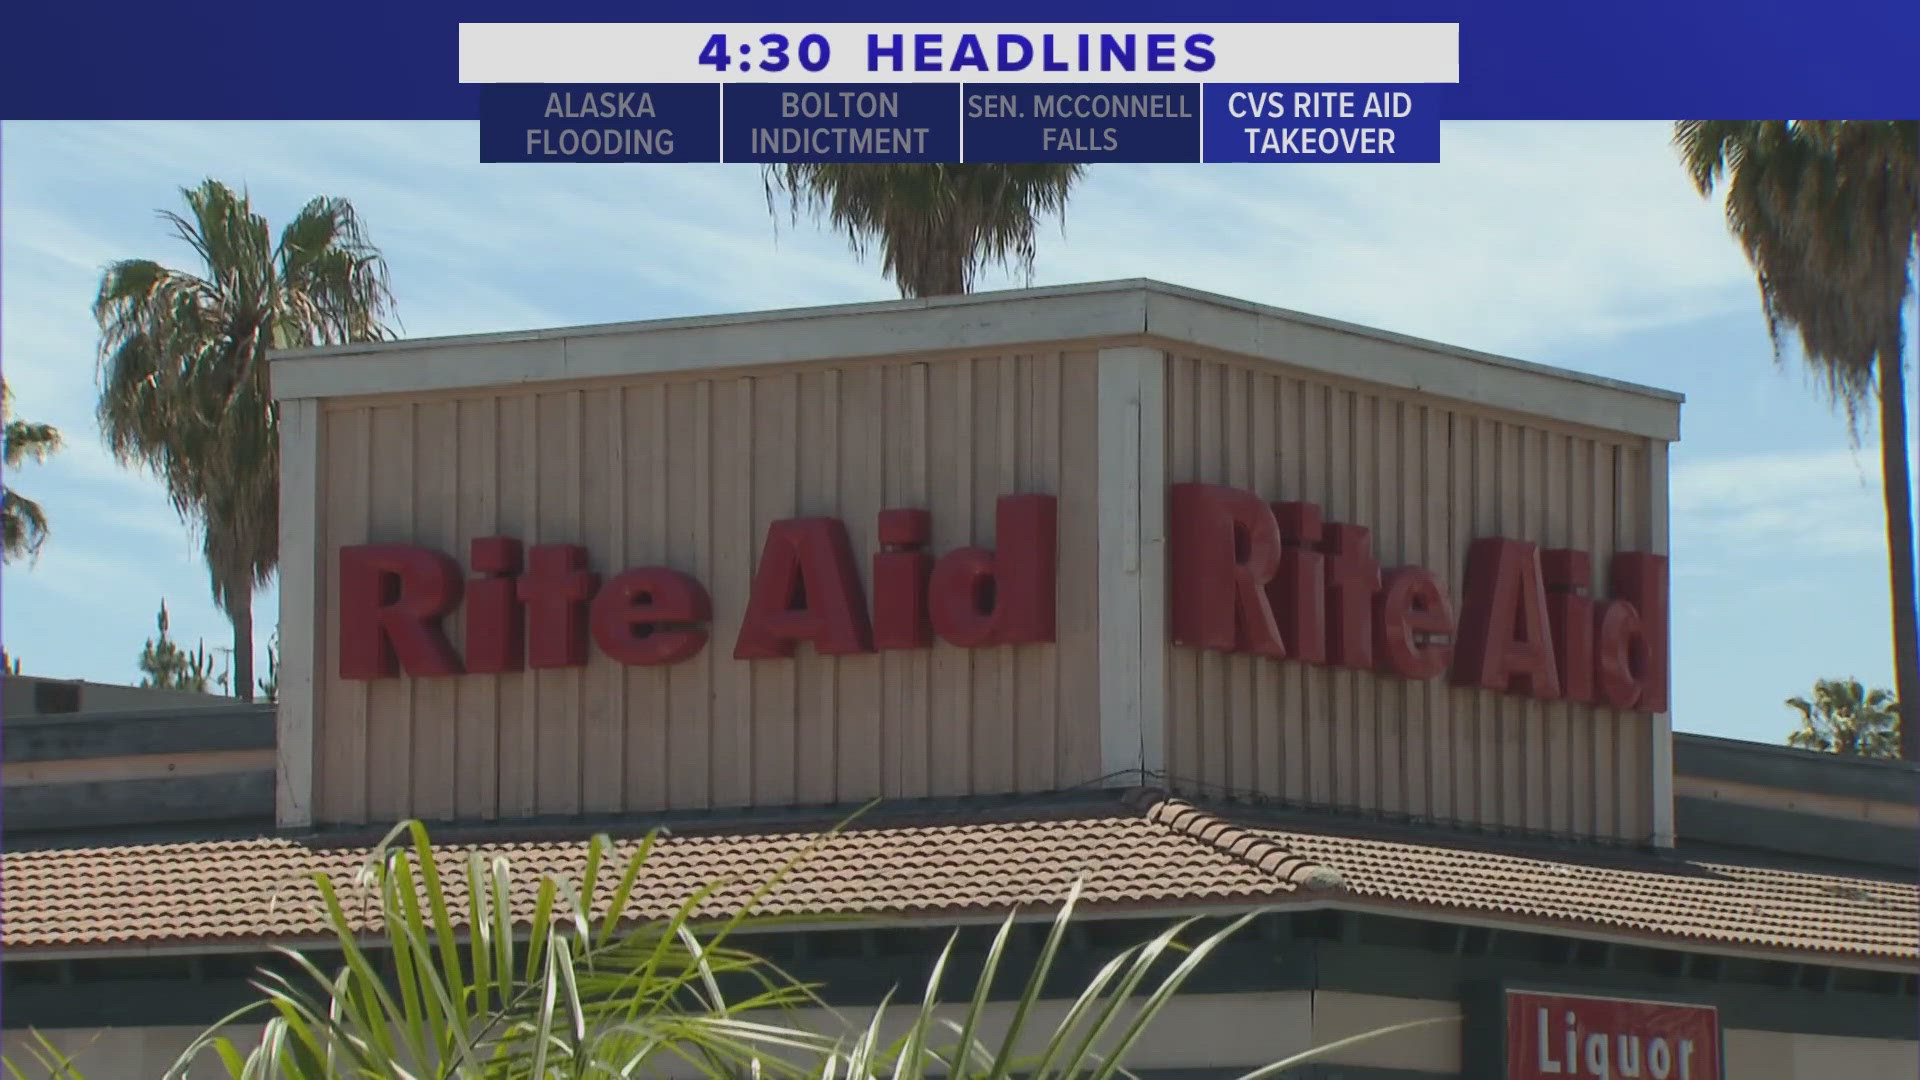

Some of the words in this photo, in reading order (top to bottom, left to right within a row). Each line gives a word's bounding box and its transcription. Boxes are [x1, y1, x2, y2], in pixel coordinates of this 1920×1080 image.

[340, 536, 713, 680] Rite
[734, 493, 1058, 660] Aid
[1170, 483, 1455, 680] Rite
[1451, 537, 1668, 713] Aid
[1537, 1007, 1694, 1080] Liquor
